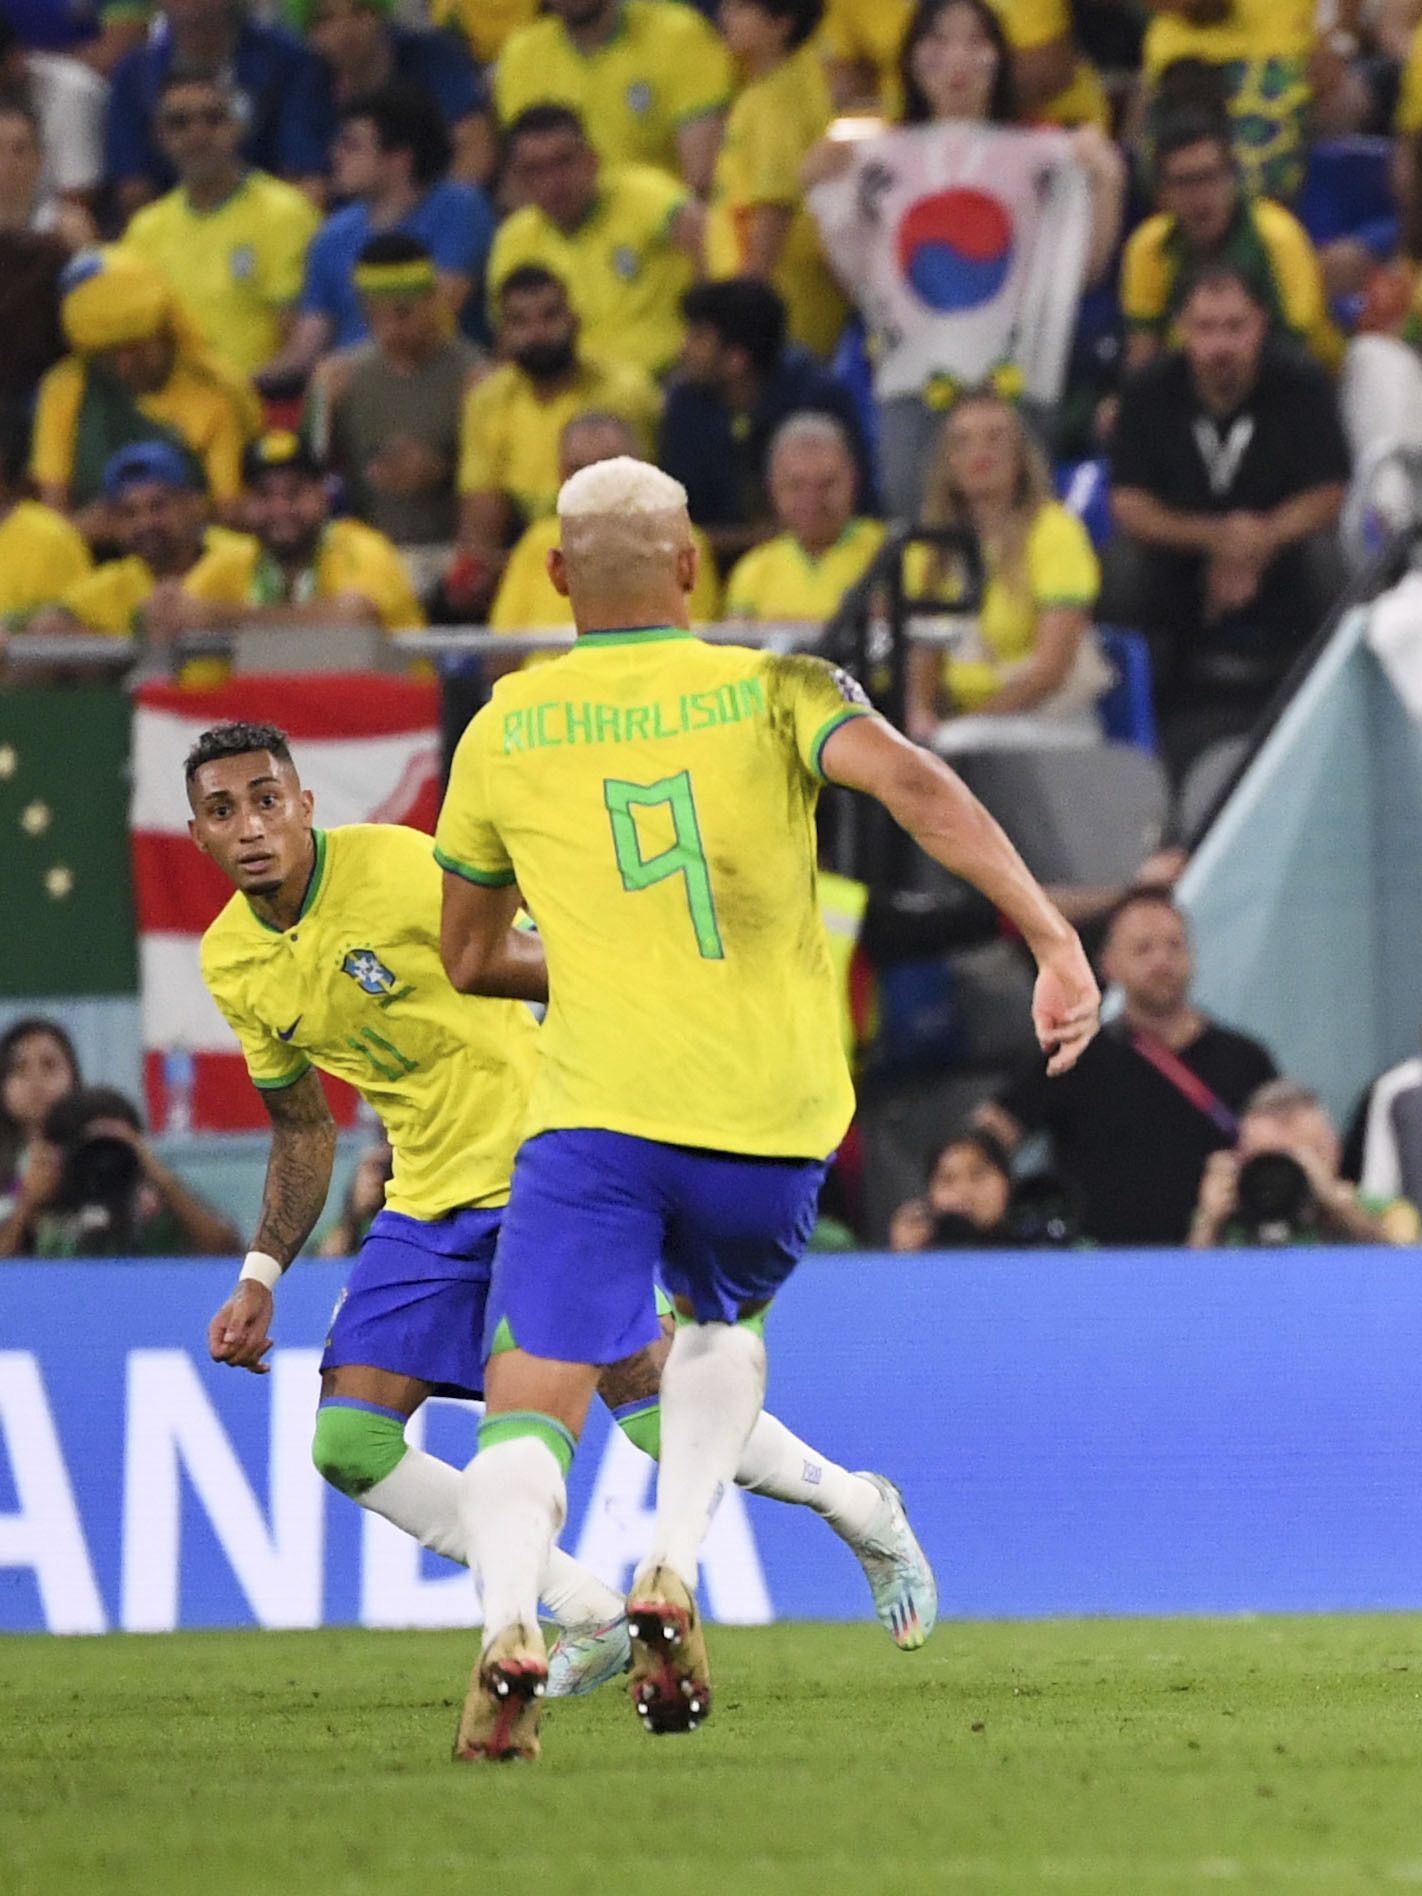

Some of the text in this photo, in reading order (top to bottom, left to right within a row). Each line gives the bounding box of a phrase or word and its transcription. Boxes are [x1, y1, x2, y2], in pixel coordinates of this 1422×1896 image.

[502, 677, 765, 755] RICHARLISON
[603, 770, 724, 959] 9
[0, 1349, 776, 1634] ANA
